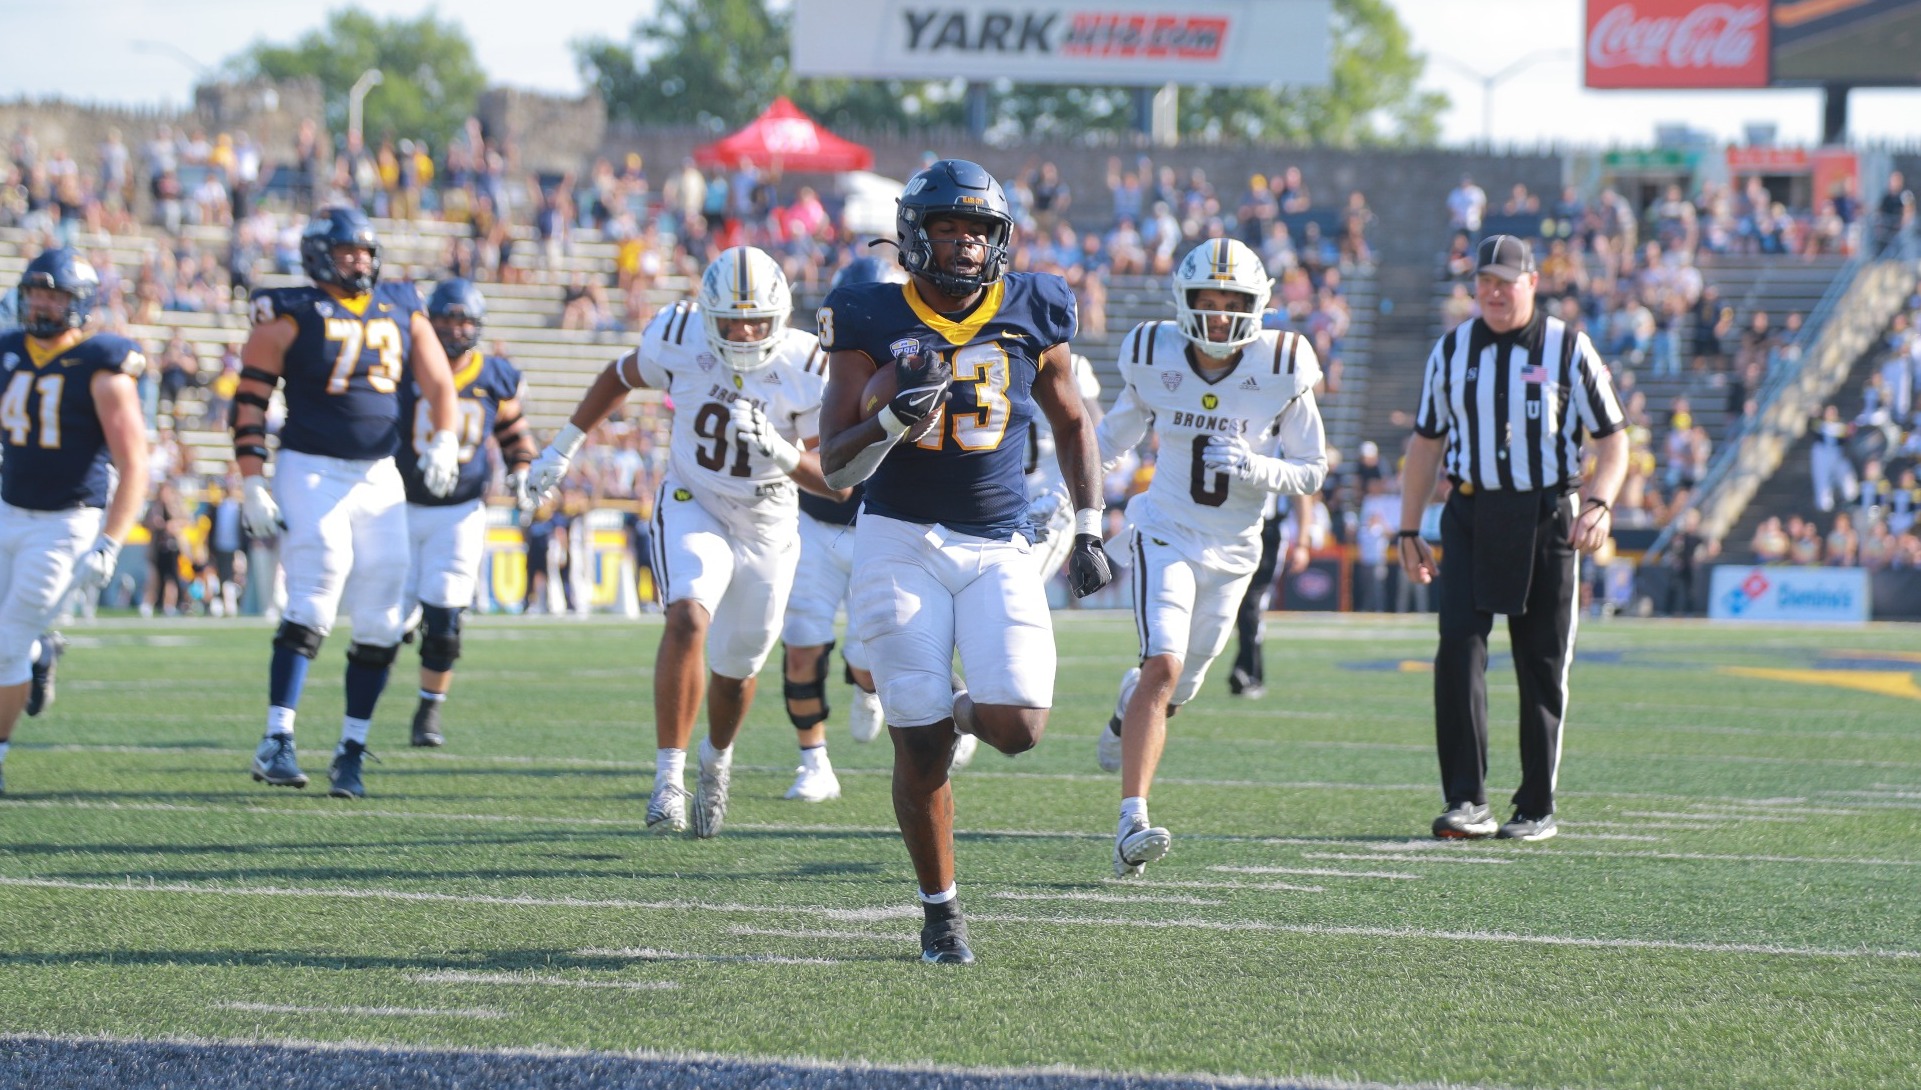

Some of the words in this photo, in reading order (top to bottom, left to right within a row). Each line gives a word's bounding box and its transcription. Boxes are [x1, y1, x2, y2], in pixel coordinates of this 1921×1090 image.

[901, 11, 1058, 53] YARK
[815, 306, 835, 348] 3
[324, 317, 402, 394] 73
[0, 370, 65, 449] 41
[1173, 411, 1249, 434] BRONCS
[1203, 395, 1219, 410] W
[1526, 400, 1540, 420] U
[694, 402, 752, 478] 91
